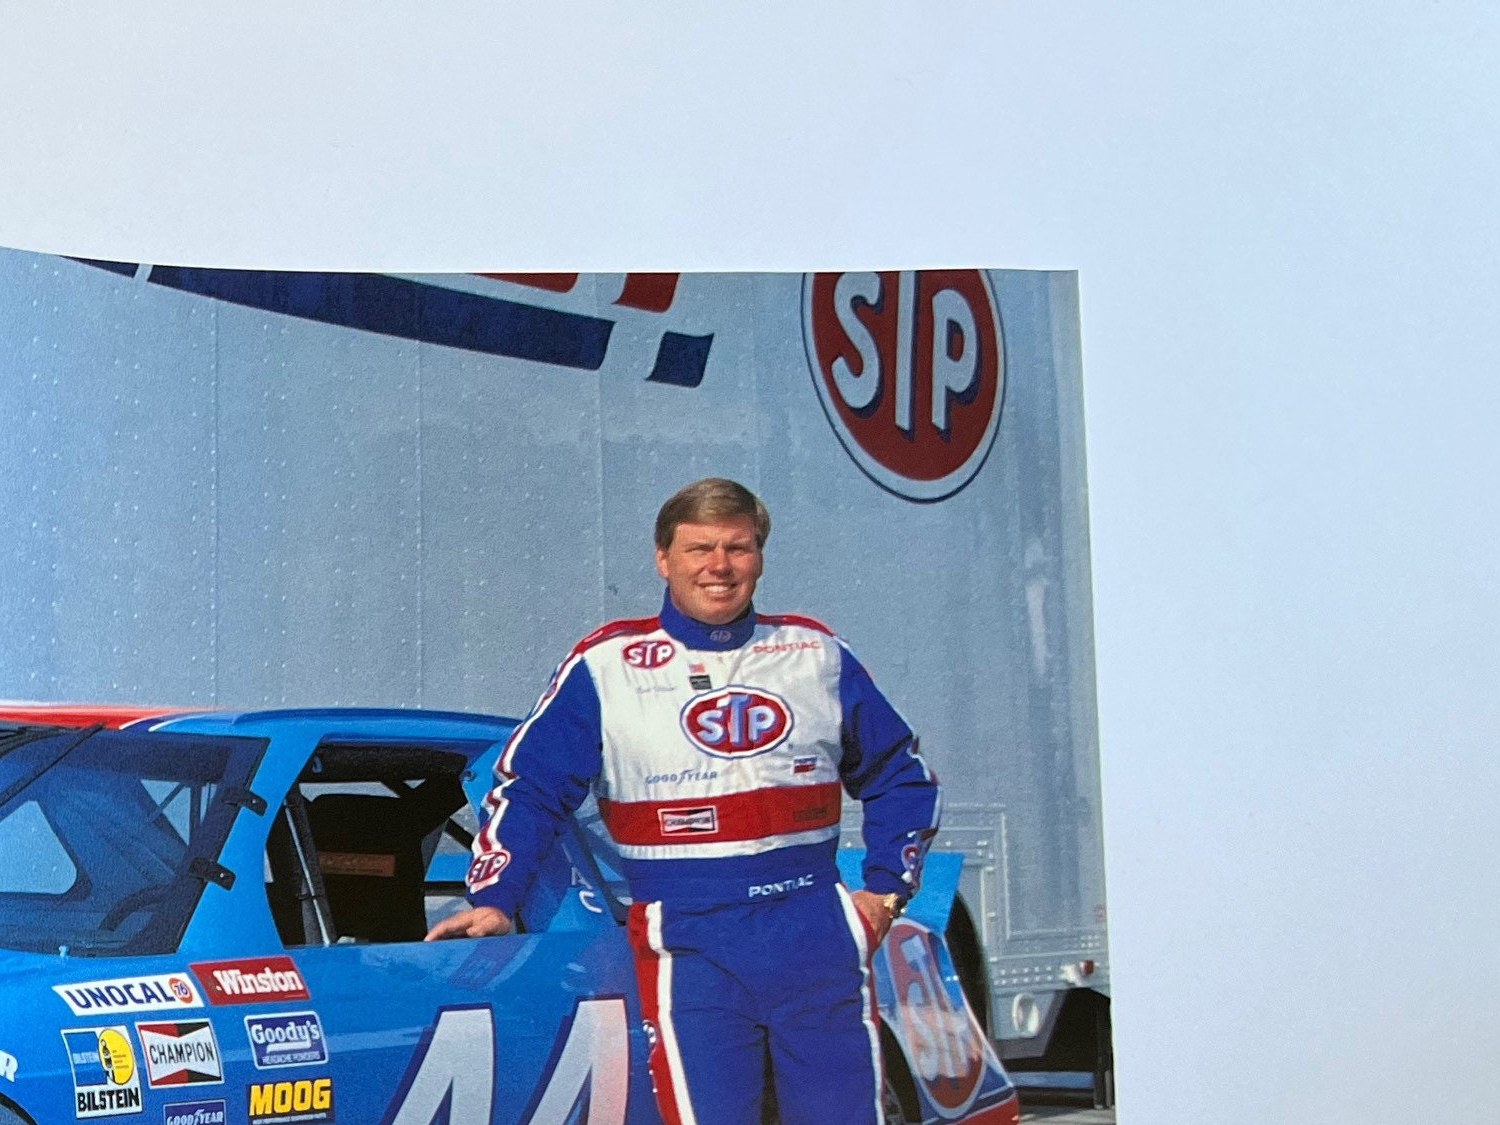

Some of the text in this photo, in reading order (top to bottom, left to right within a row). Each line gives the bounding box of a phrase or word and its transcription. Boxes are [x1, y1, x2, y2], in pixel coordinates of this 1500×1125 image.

[627, 642, 674, 668] STP
[753, 641, 820, 654] PONTIAC
[696, 694, 777, 744] STP
[645, 769, 718, 785] GOODYEAR
[468, 853, 508, 885] STP
[748, 875, 815, 898] PONTIAC
[213, 966, 304, 996] Winston
[65, 980, 189, 1010] UNOCAL 76
[250, 1020, 321, 1047] Goody's
[150, 1041, 215, 1065] CHAMPION
[77, 1086, 140, 1113] BILSTEIN
[249, 1078, 332, 1117] MOOG
